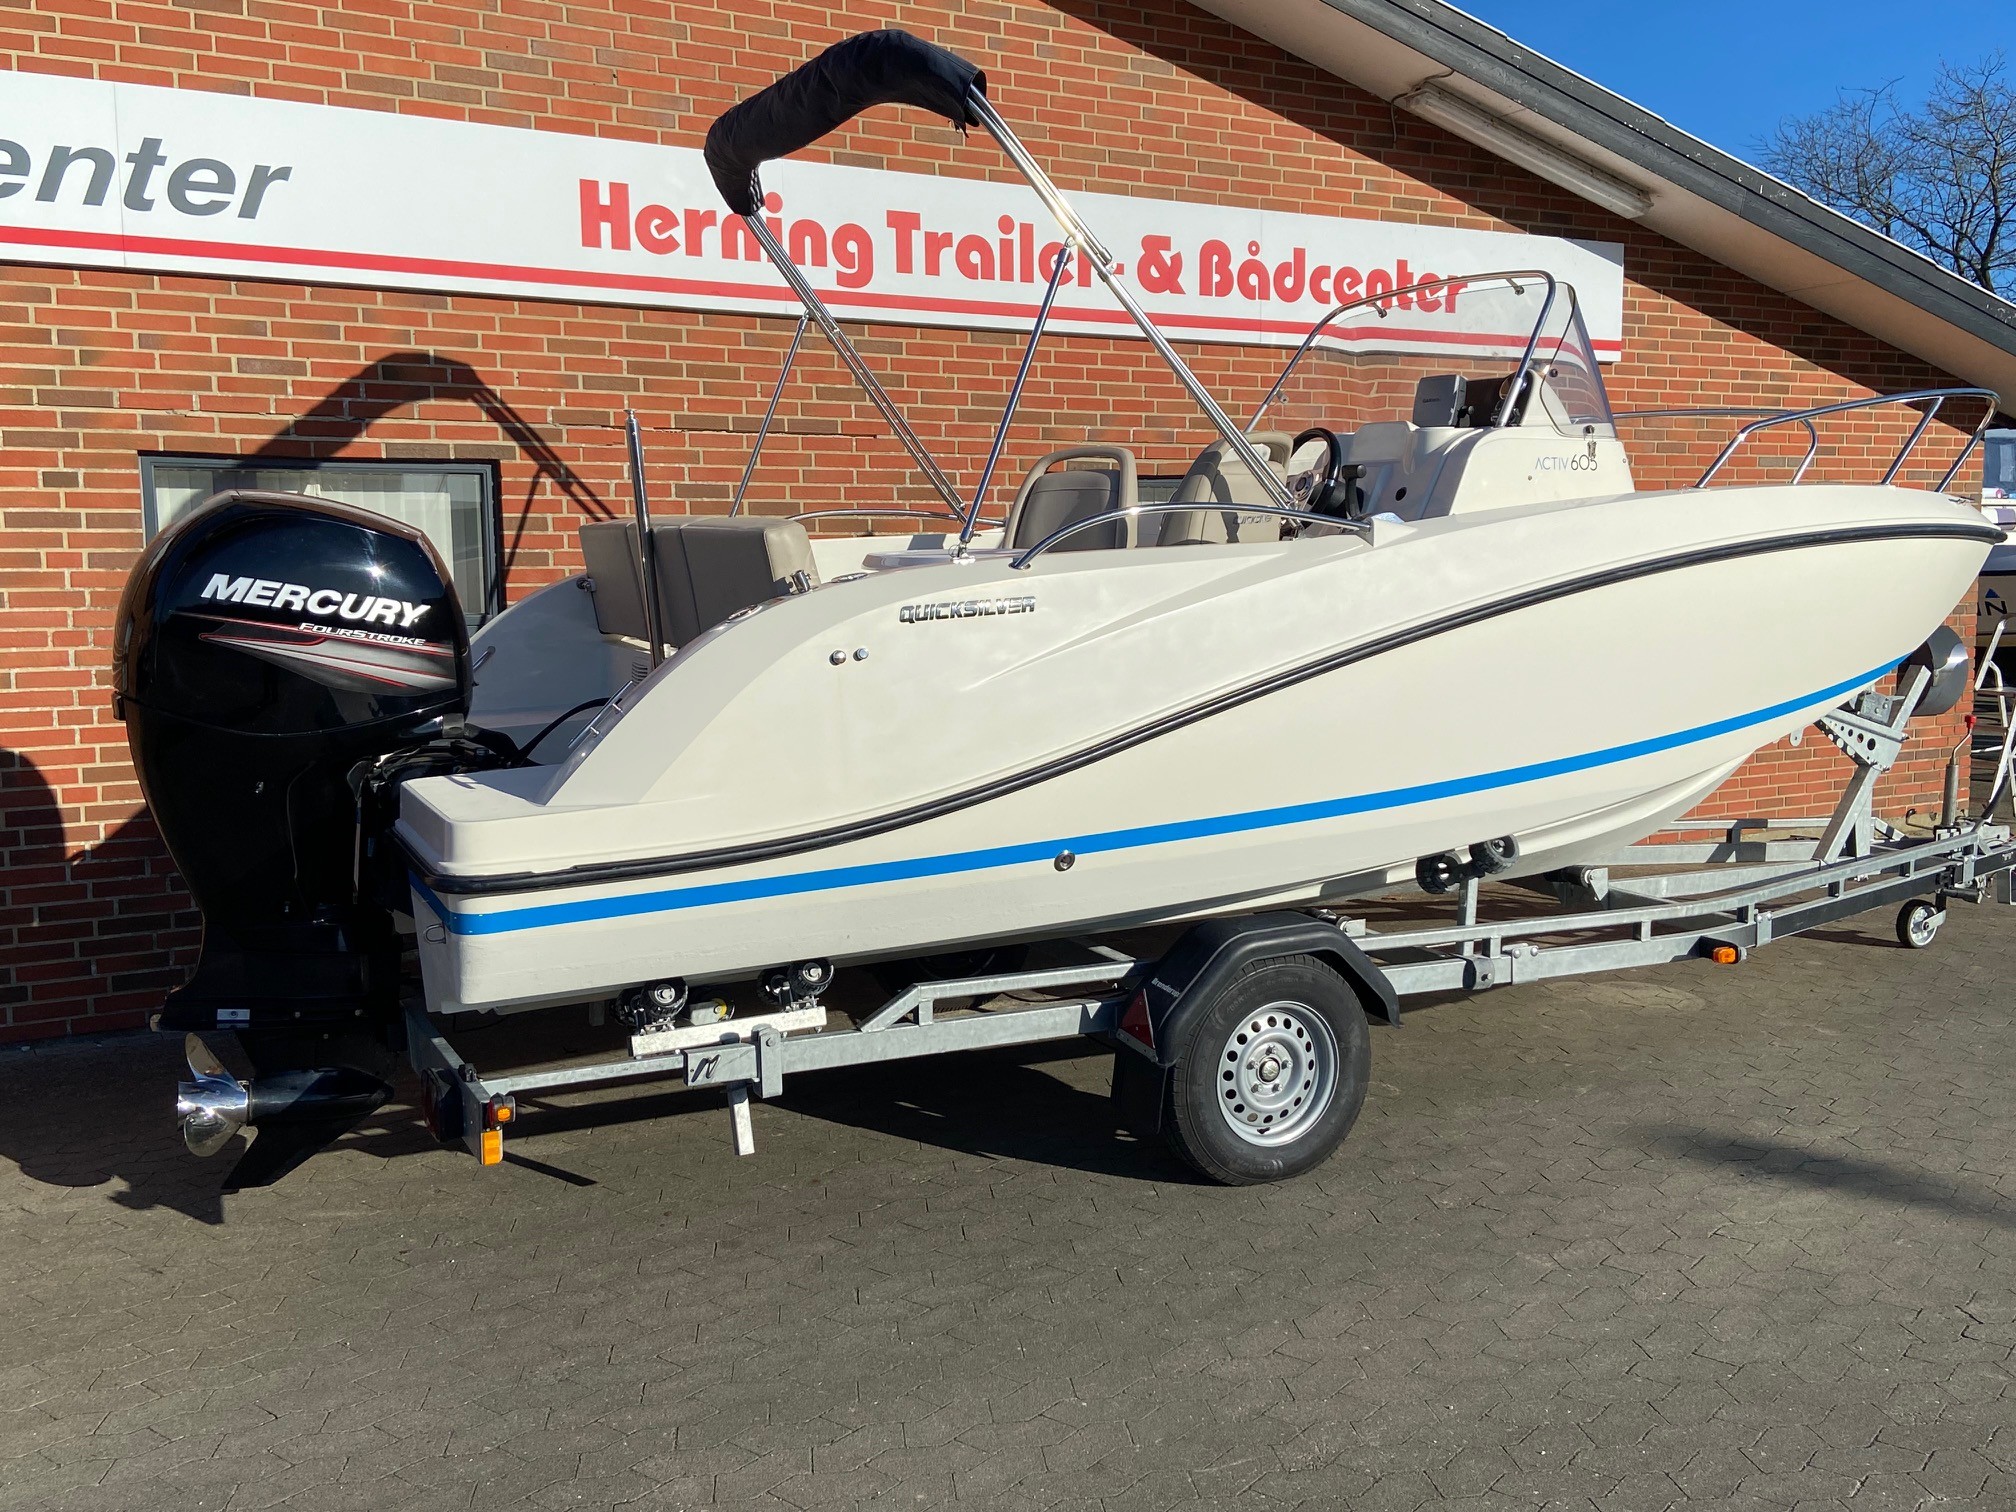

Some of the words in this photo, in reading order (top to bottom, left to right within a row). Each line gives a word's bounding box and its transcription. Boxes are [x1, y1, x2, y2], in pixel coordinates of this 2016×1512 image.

[579, 178, 874, 289] Herning
[1137, 234, 1186, 294] &
[1199, 239, 1468, 314] Bådcenter
[1535, 456, 1569, 471] ACTIV
[1570, 453, 1598, 472] 605
[200, 573, 431, 628] MERCURY
[899, 595, 1036, 624] QUICKSILVER
